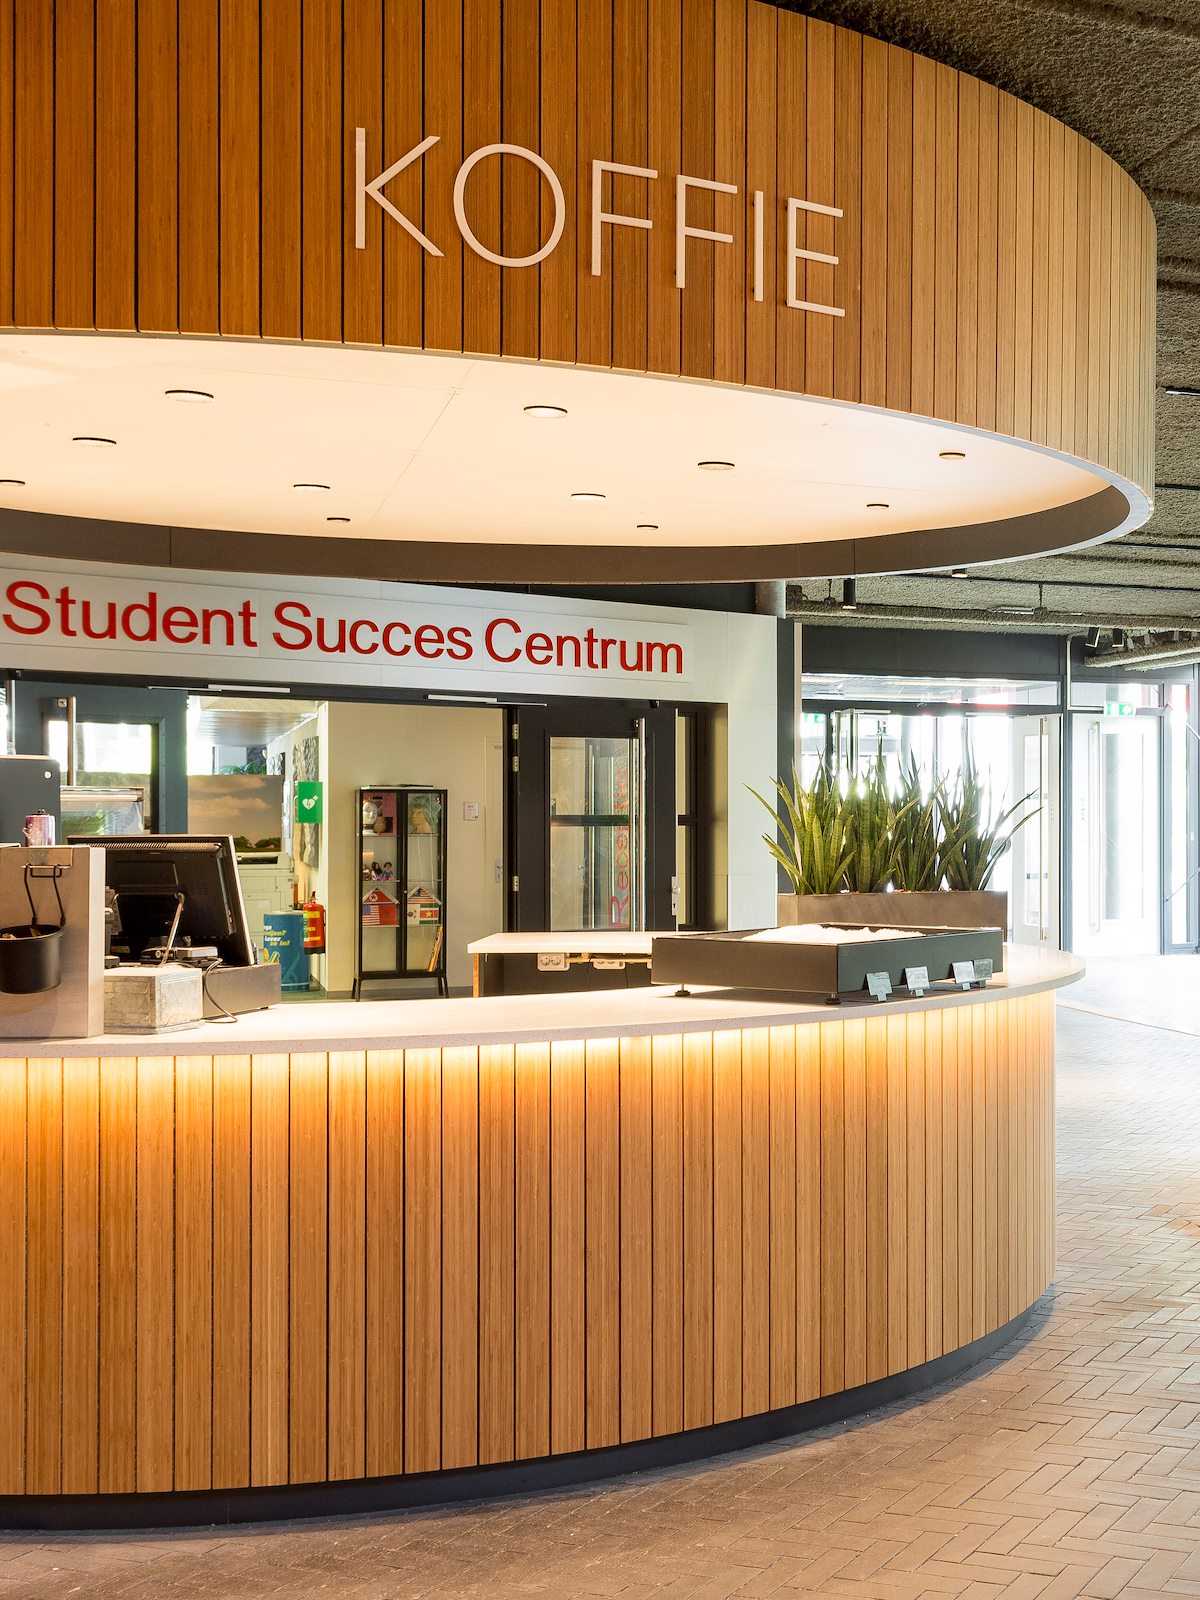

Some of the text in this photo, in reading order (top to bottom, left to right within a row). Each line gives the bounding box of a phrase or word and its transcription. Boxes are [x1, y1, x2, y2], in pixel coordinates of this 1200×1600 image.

[354, 126, 846, 318] KOFFIE
[3, 580, 684, 674] Student Succes Centrum
[609, 768, 629, 927] Recetie
